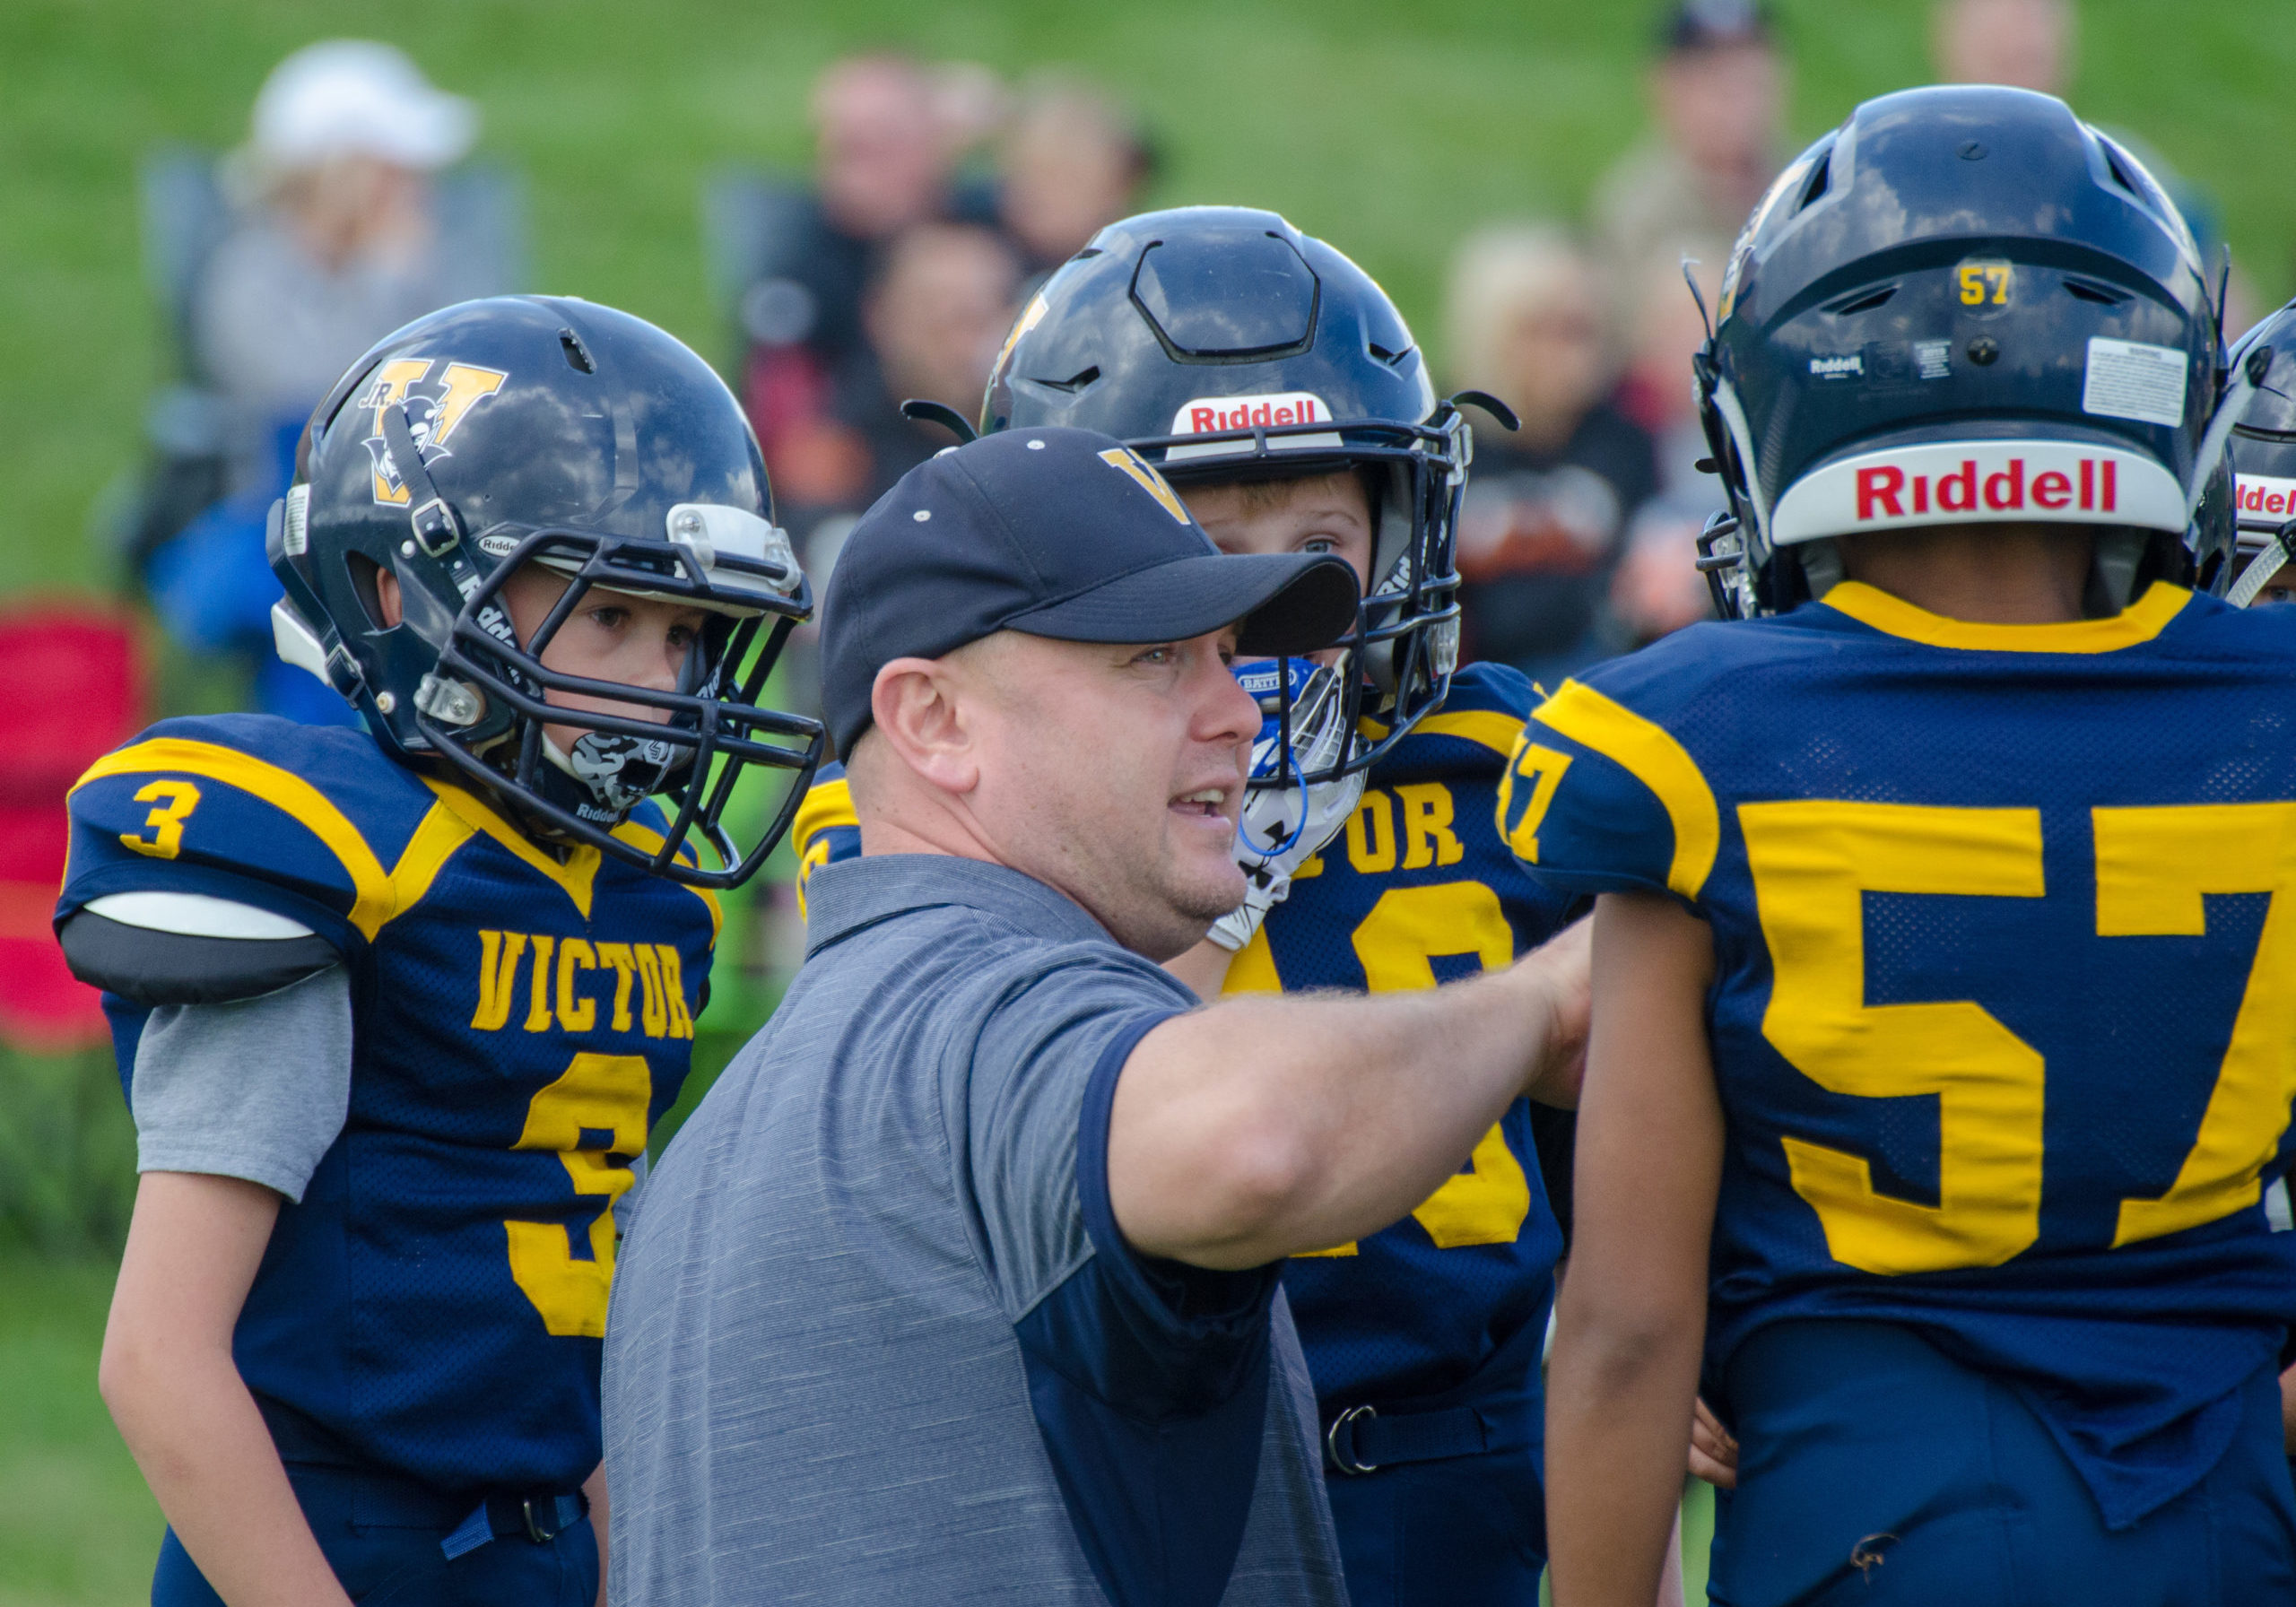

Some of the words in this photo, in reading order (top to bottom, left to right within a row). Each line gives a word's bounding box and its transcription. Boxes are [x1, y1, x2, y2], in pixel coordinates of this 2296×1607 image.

[1960, 267, 2009, 305] 57
[1191, 400, 1315, 433] Riddell
[1097, 448, 1191, 525] V
[1857, 459, 2117, 521] Riddell
[119, 779, 201, 860] 3
[470, 929, 694, 1040] VICTOR
[1738, 800, 2296, 1275] 57
